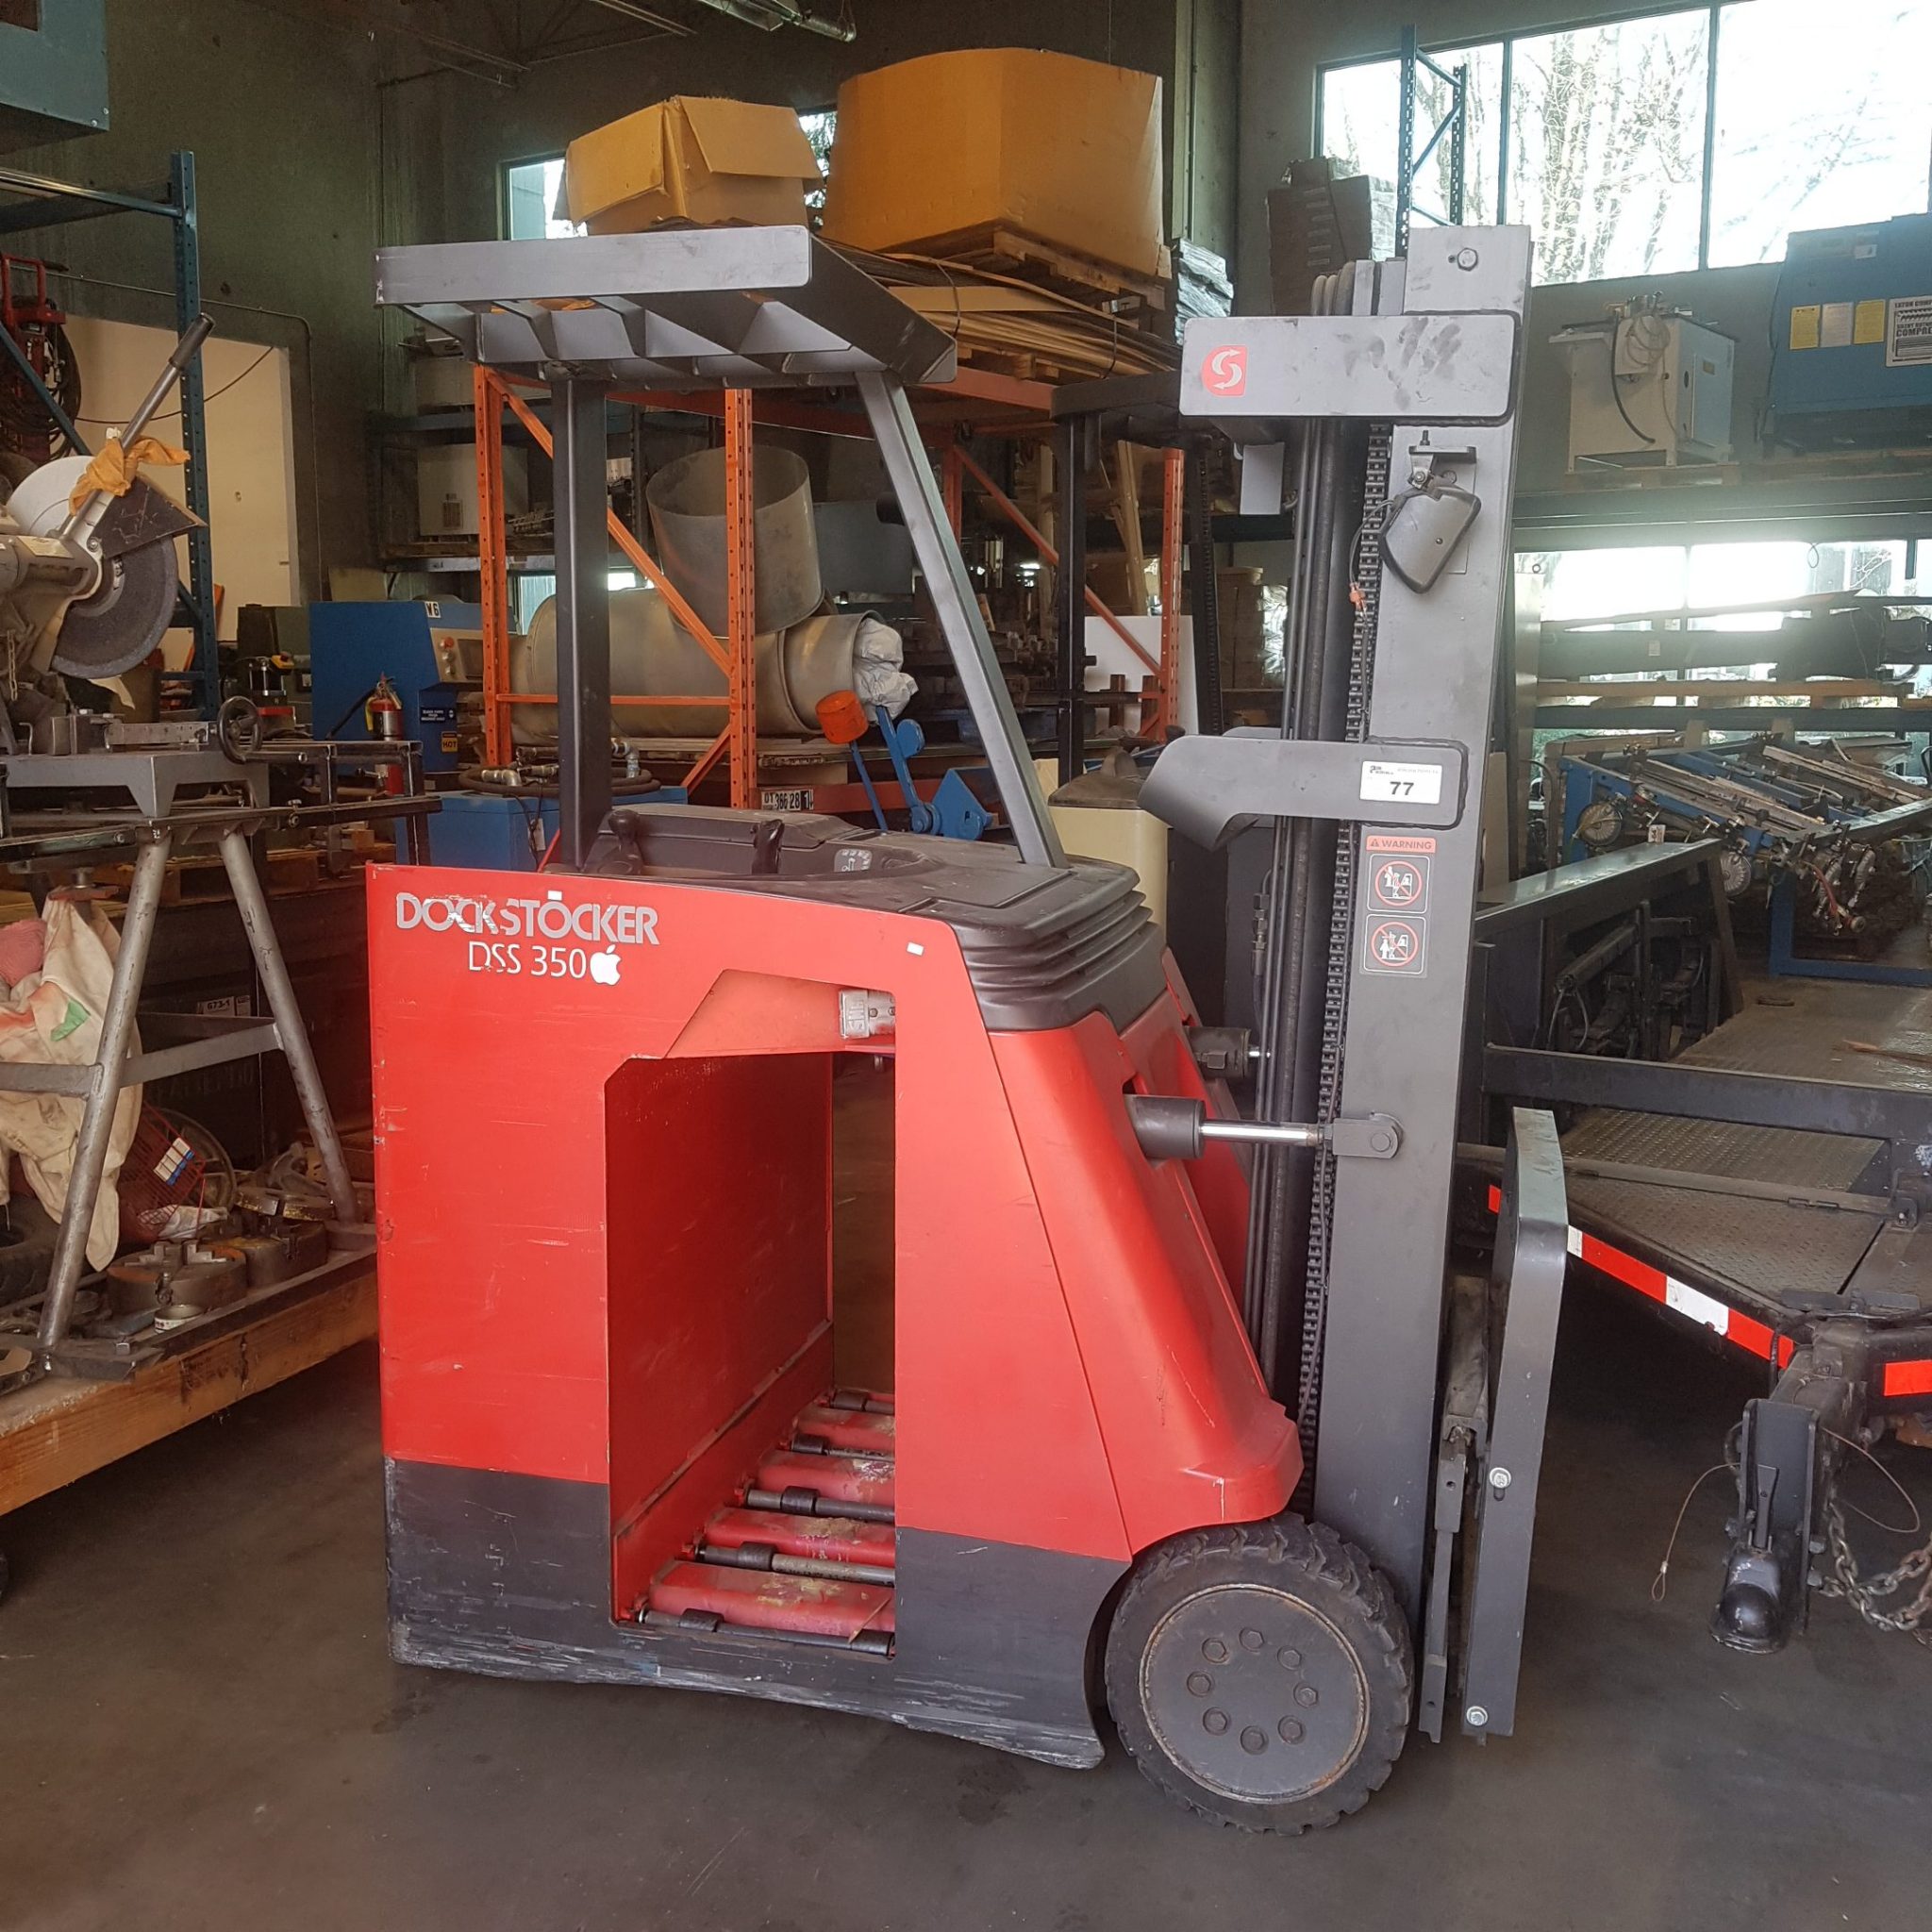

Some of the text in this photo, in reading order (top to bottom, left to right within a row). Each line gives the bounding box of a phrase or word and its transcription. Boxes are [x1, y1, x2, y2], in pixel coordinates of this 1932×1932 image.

[1390, 781, 1414, 795] 77
[1382, 839, 1432, 850] WARNING
[469, 941, 587, 978] DSS 350
